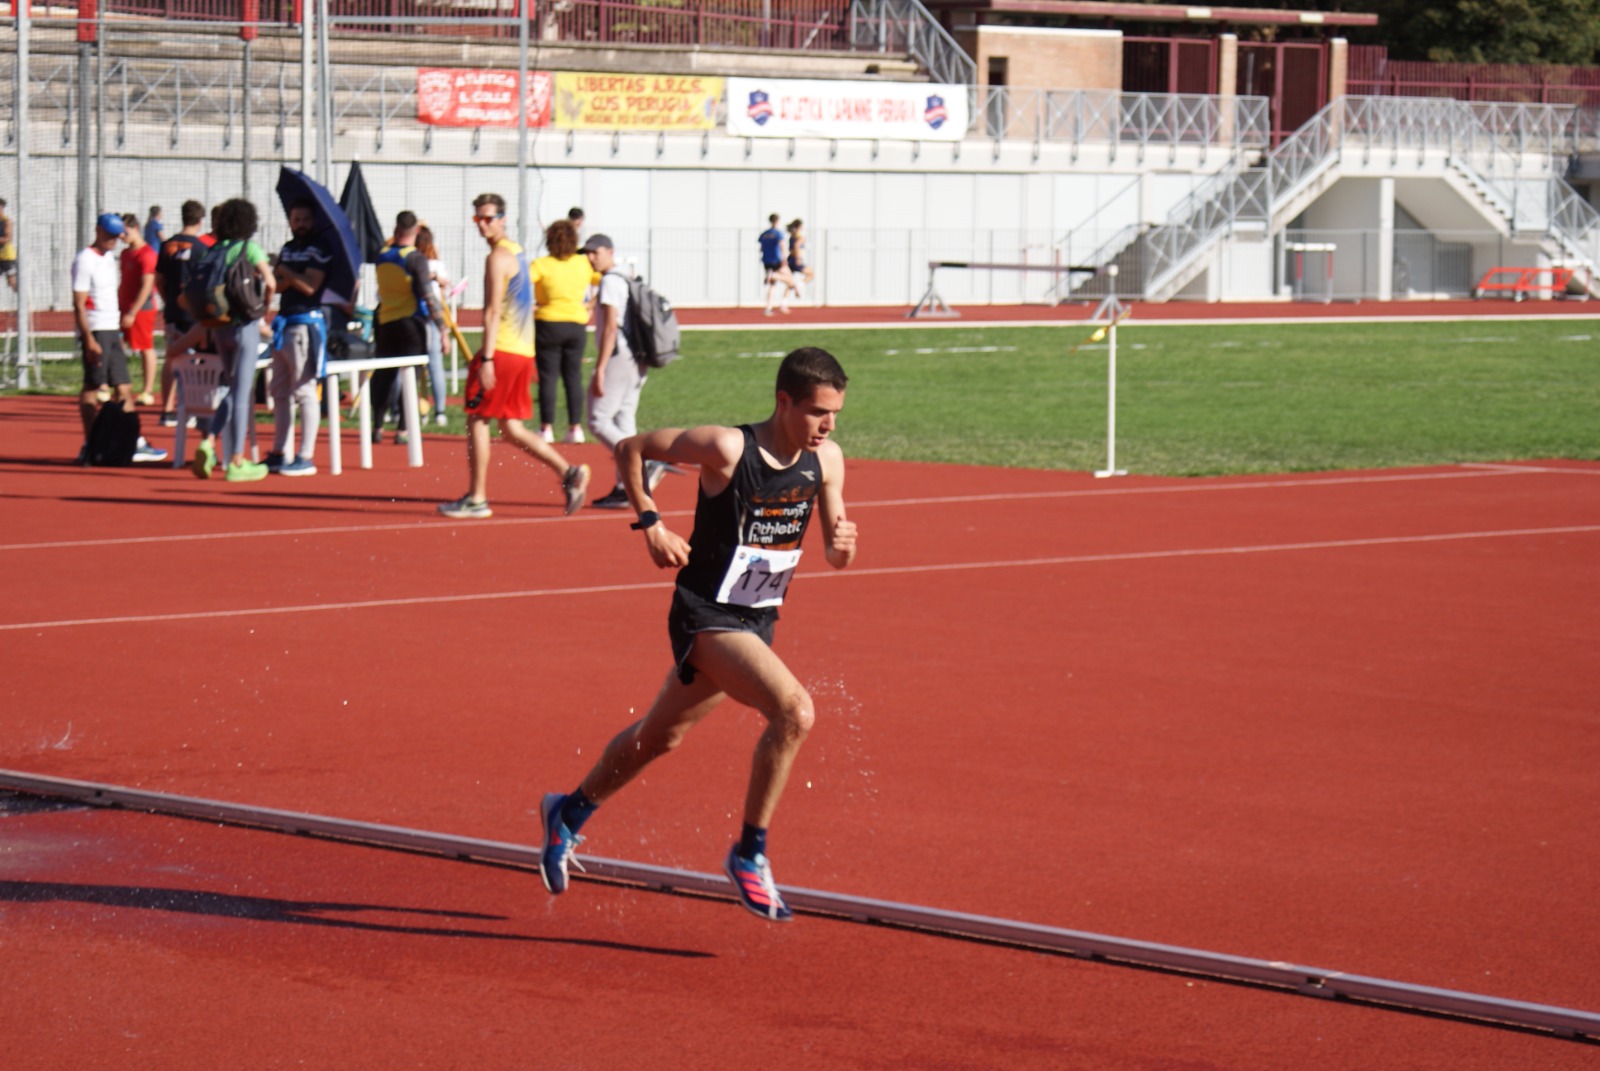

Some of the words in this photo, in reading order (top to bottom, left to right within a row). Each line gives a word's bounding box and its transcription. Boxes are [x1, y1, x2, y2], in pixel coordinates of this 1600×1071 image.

[577, 76, 645, 92] LIBERTAS
[591, 96, 620, 111] CUS
[626, 96, 691, 112] PERUGIA
[740, 569, 784, 592] 174
